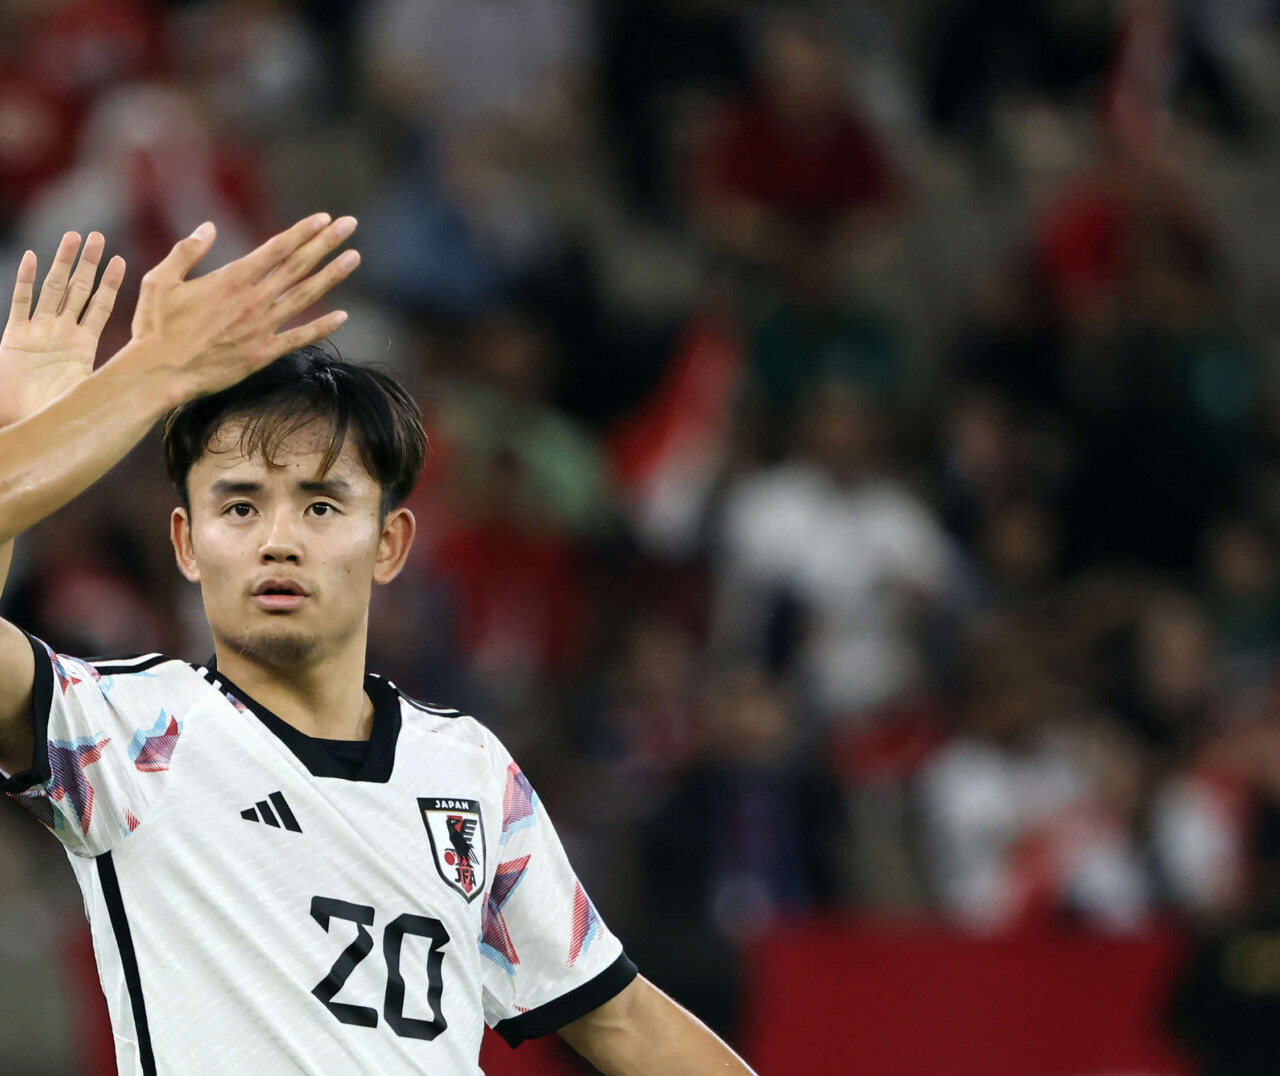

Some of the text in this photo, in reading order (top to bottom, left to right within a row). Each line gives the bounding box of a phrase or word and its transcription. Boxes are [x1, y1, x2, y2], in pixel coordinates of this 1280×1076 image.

[435, 800, 469, 810] JAPAN
[455, 867, 476, 887] JFA
[310, 895, 451, 1041] 20
